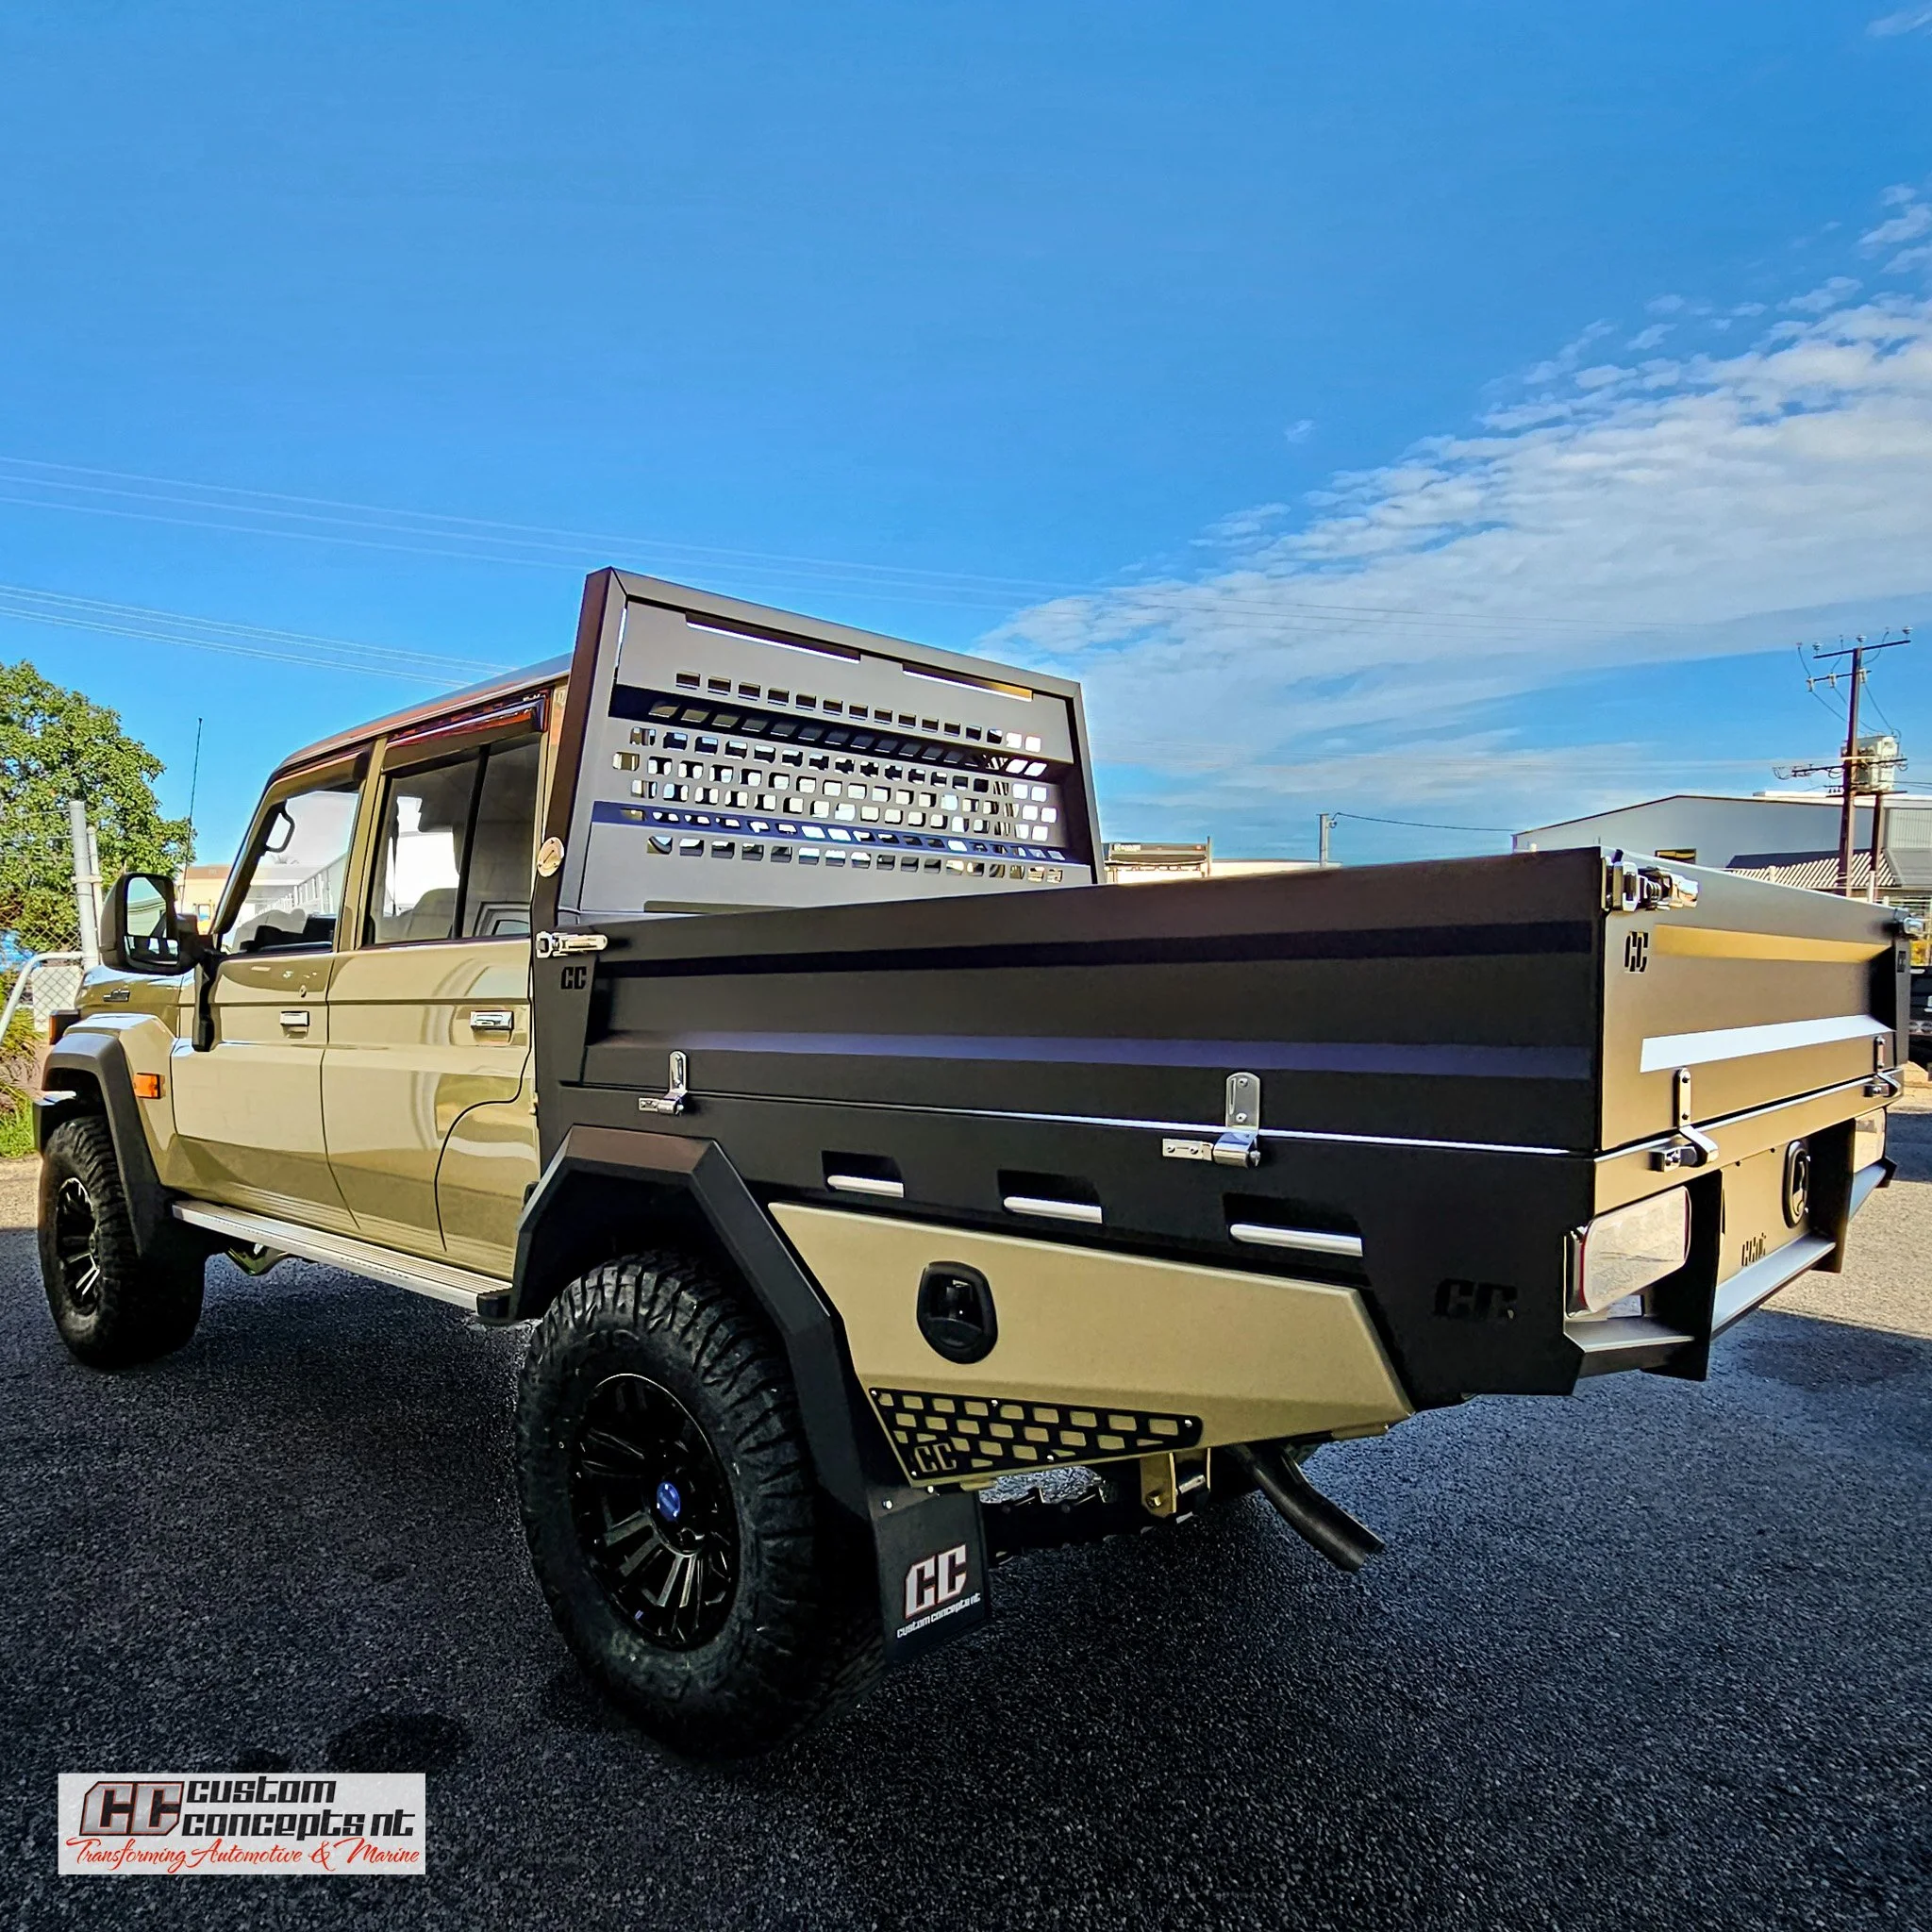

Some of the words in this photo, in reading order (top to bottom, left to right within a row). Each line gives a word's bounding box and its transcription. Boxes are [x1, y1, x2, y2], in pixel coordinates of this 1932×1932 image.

[560, 966, 587, 990] CC
[914, 1442, 957, 1473] CC
[905, 1542, 967, 1619] CC
